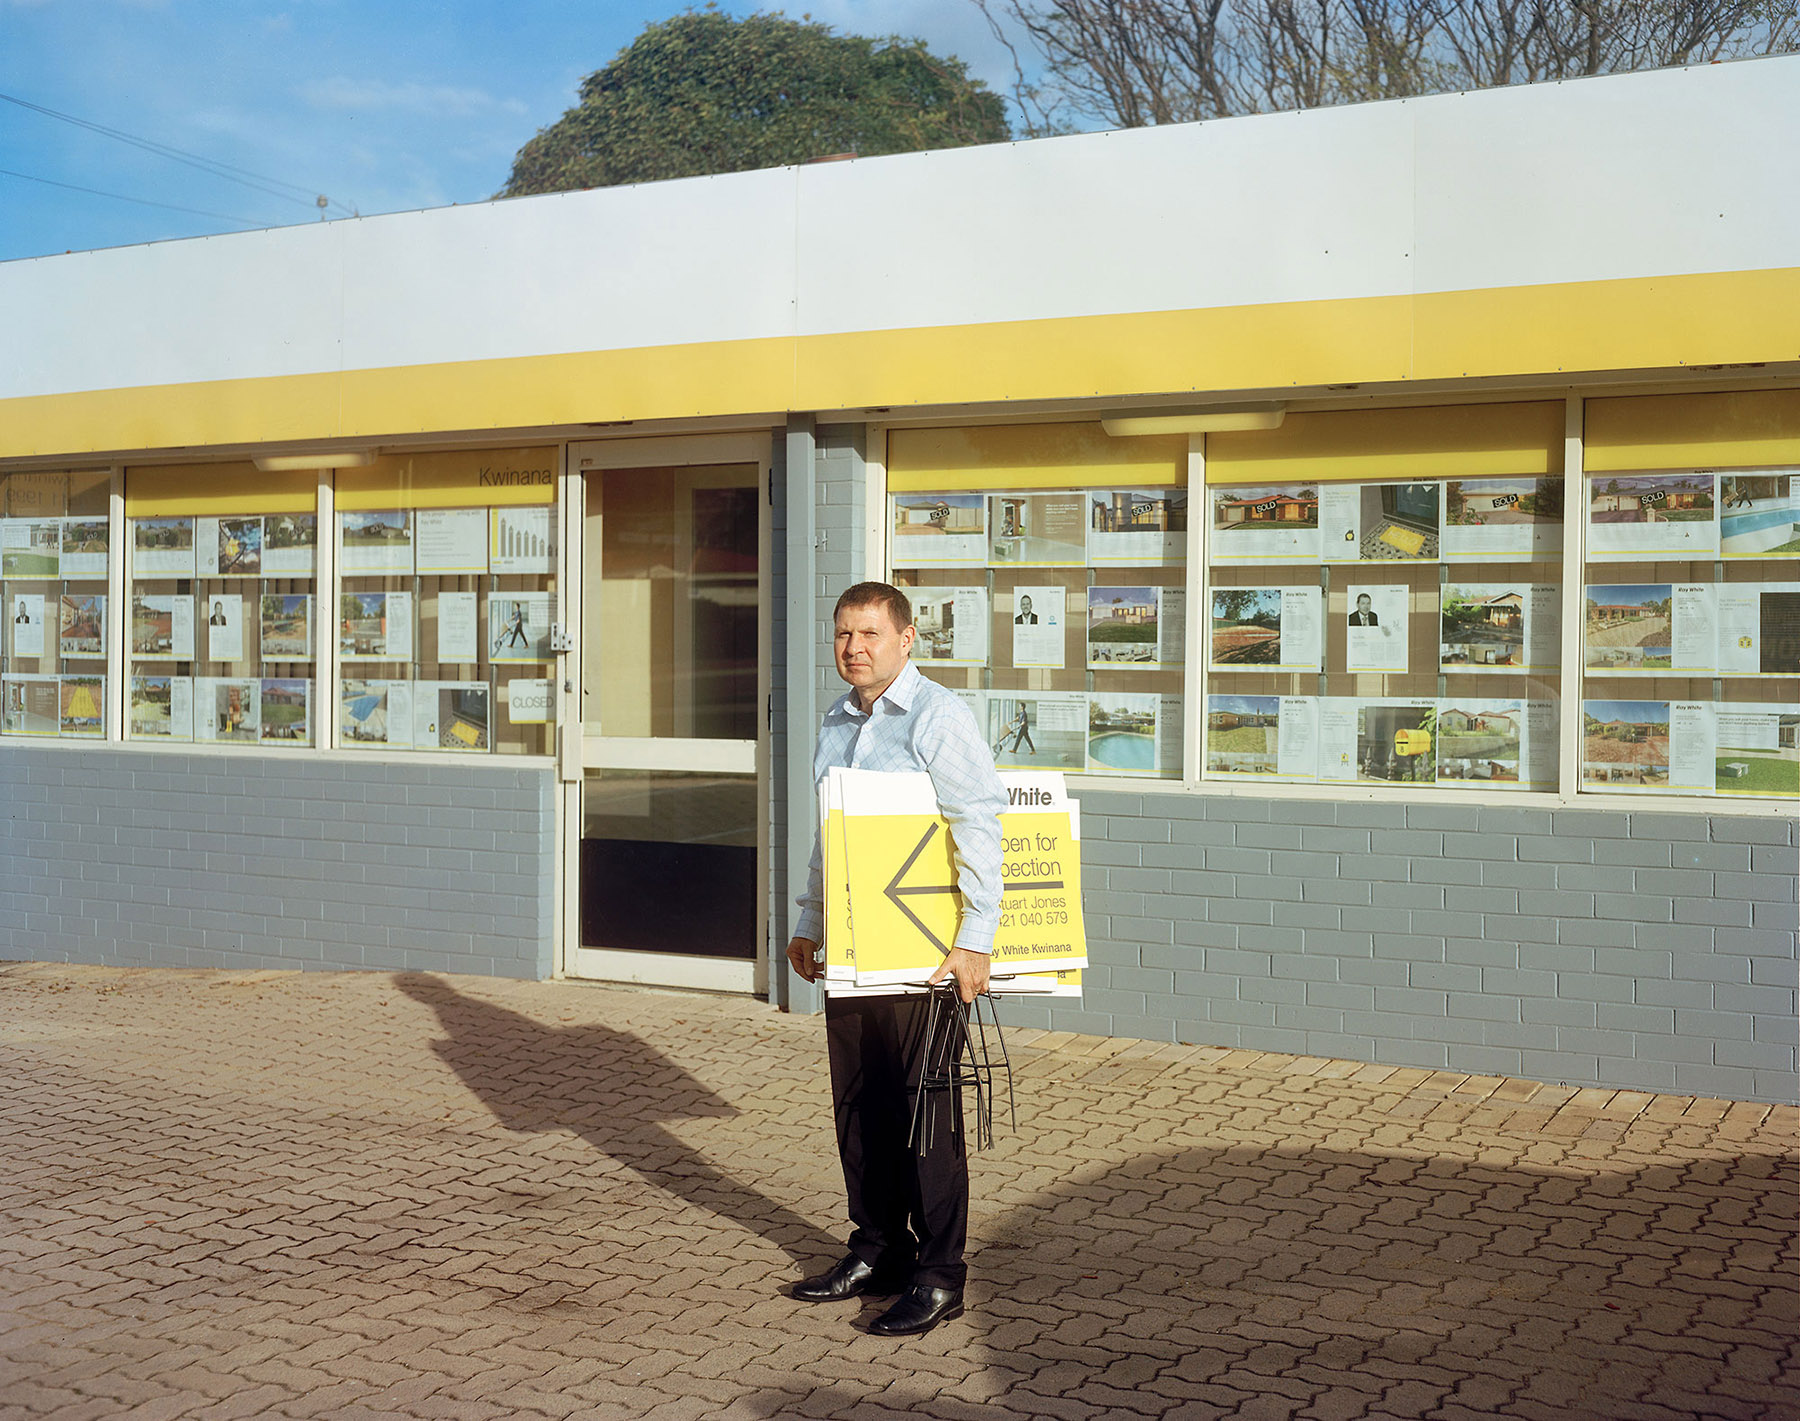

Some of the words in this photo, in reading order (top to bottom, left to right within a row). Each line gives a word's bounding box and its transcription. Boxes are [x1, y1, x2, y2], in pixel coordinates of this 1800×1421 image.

[479, 467, 553, 487] Kwinana
[1493, 495, 1517, 507] SOLD
[1641, 491, 1664, 505] SOLD
[1132, 504, 1151, 516] SOLD
[1256, 500, 1276, 513] SOLD
[931, 508, 949, 520] SOLD
[512, 696, 554, 708] CLOSED
[1001, 837, 1031, 852] pen
[1036, 832, 1058, 852] for
[1001, 858, 1062, 878] pection
[998, 896, 1028, 910] tuart
[1030, 896, 1066, 908] Jones
[1020, 912, 1042, 926] 040
[1046, 910, 1068, 924] 579
[1002, 944, 1030, 956] White
[1032, 942, 1072, 954] Kwinana
